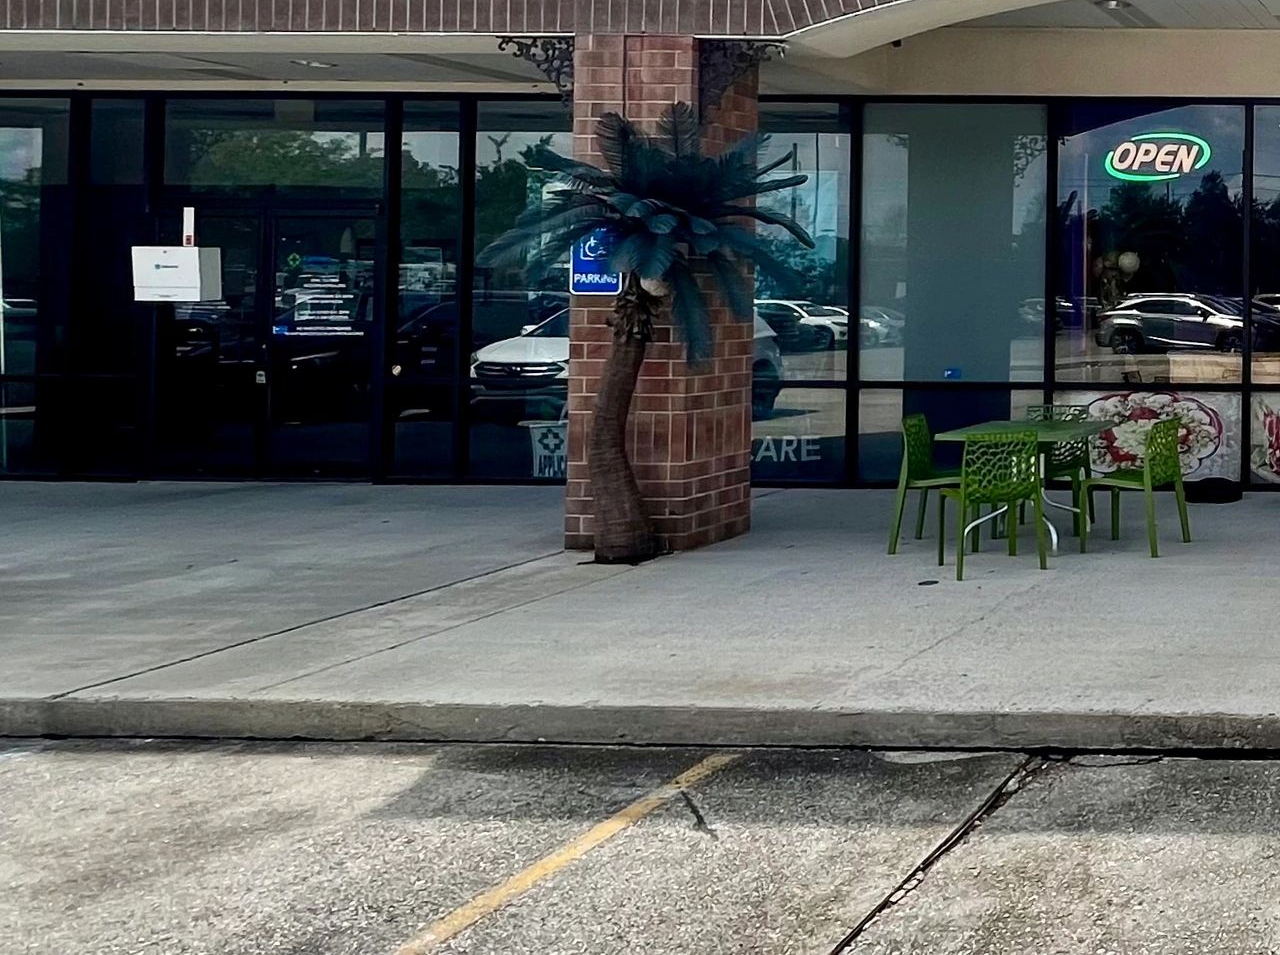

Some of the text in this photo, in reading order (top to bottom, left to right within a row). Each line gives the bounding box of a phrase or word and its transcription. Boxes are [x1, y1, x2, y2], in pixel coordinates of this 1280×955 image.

[1112, 141, 1201, 174] OPEN
[573, 273, 617, 284] PARKING
[751, 435, 822, 462] ARE
